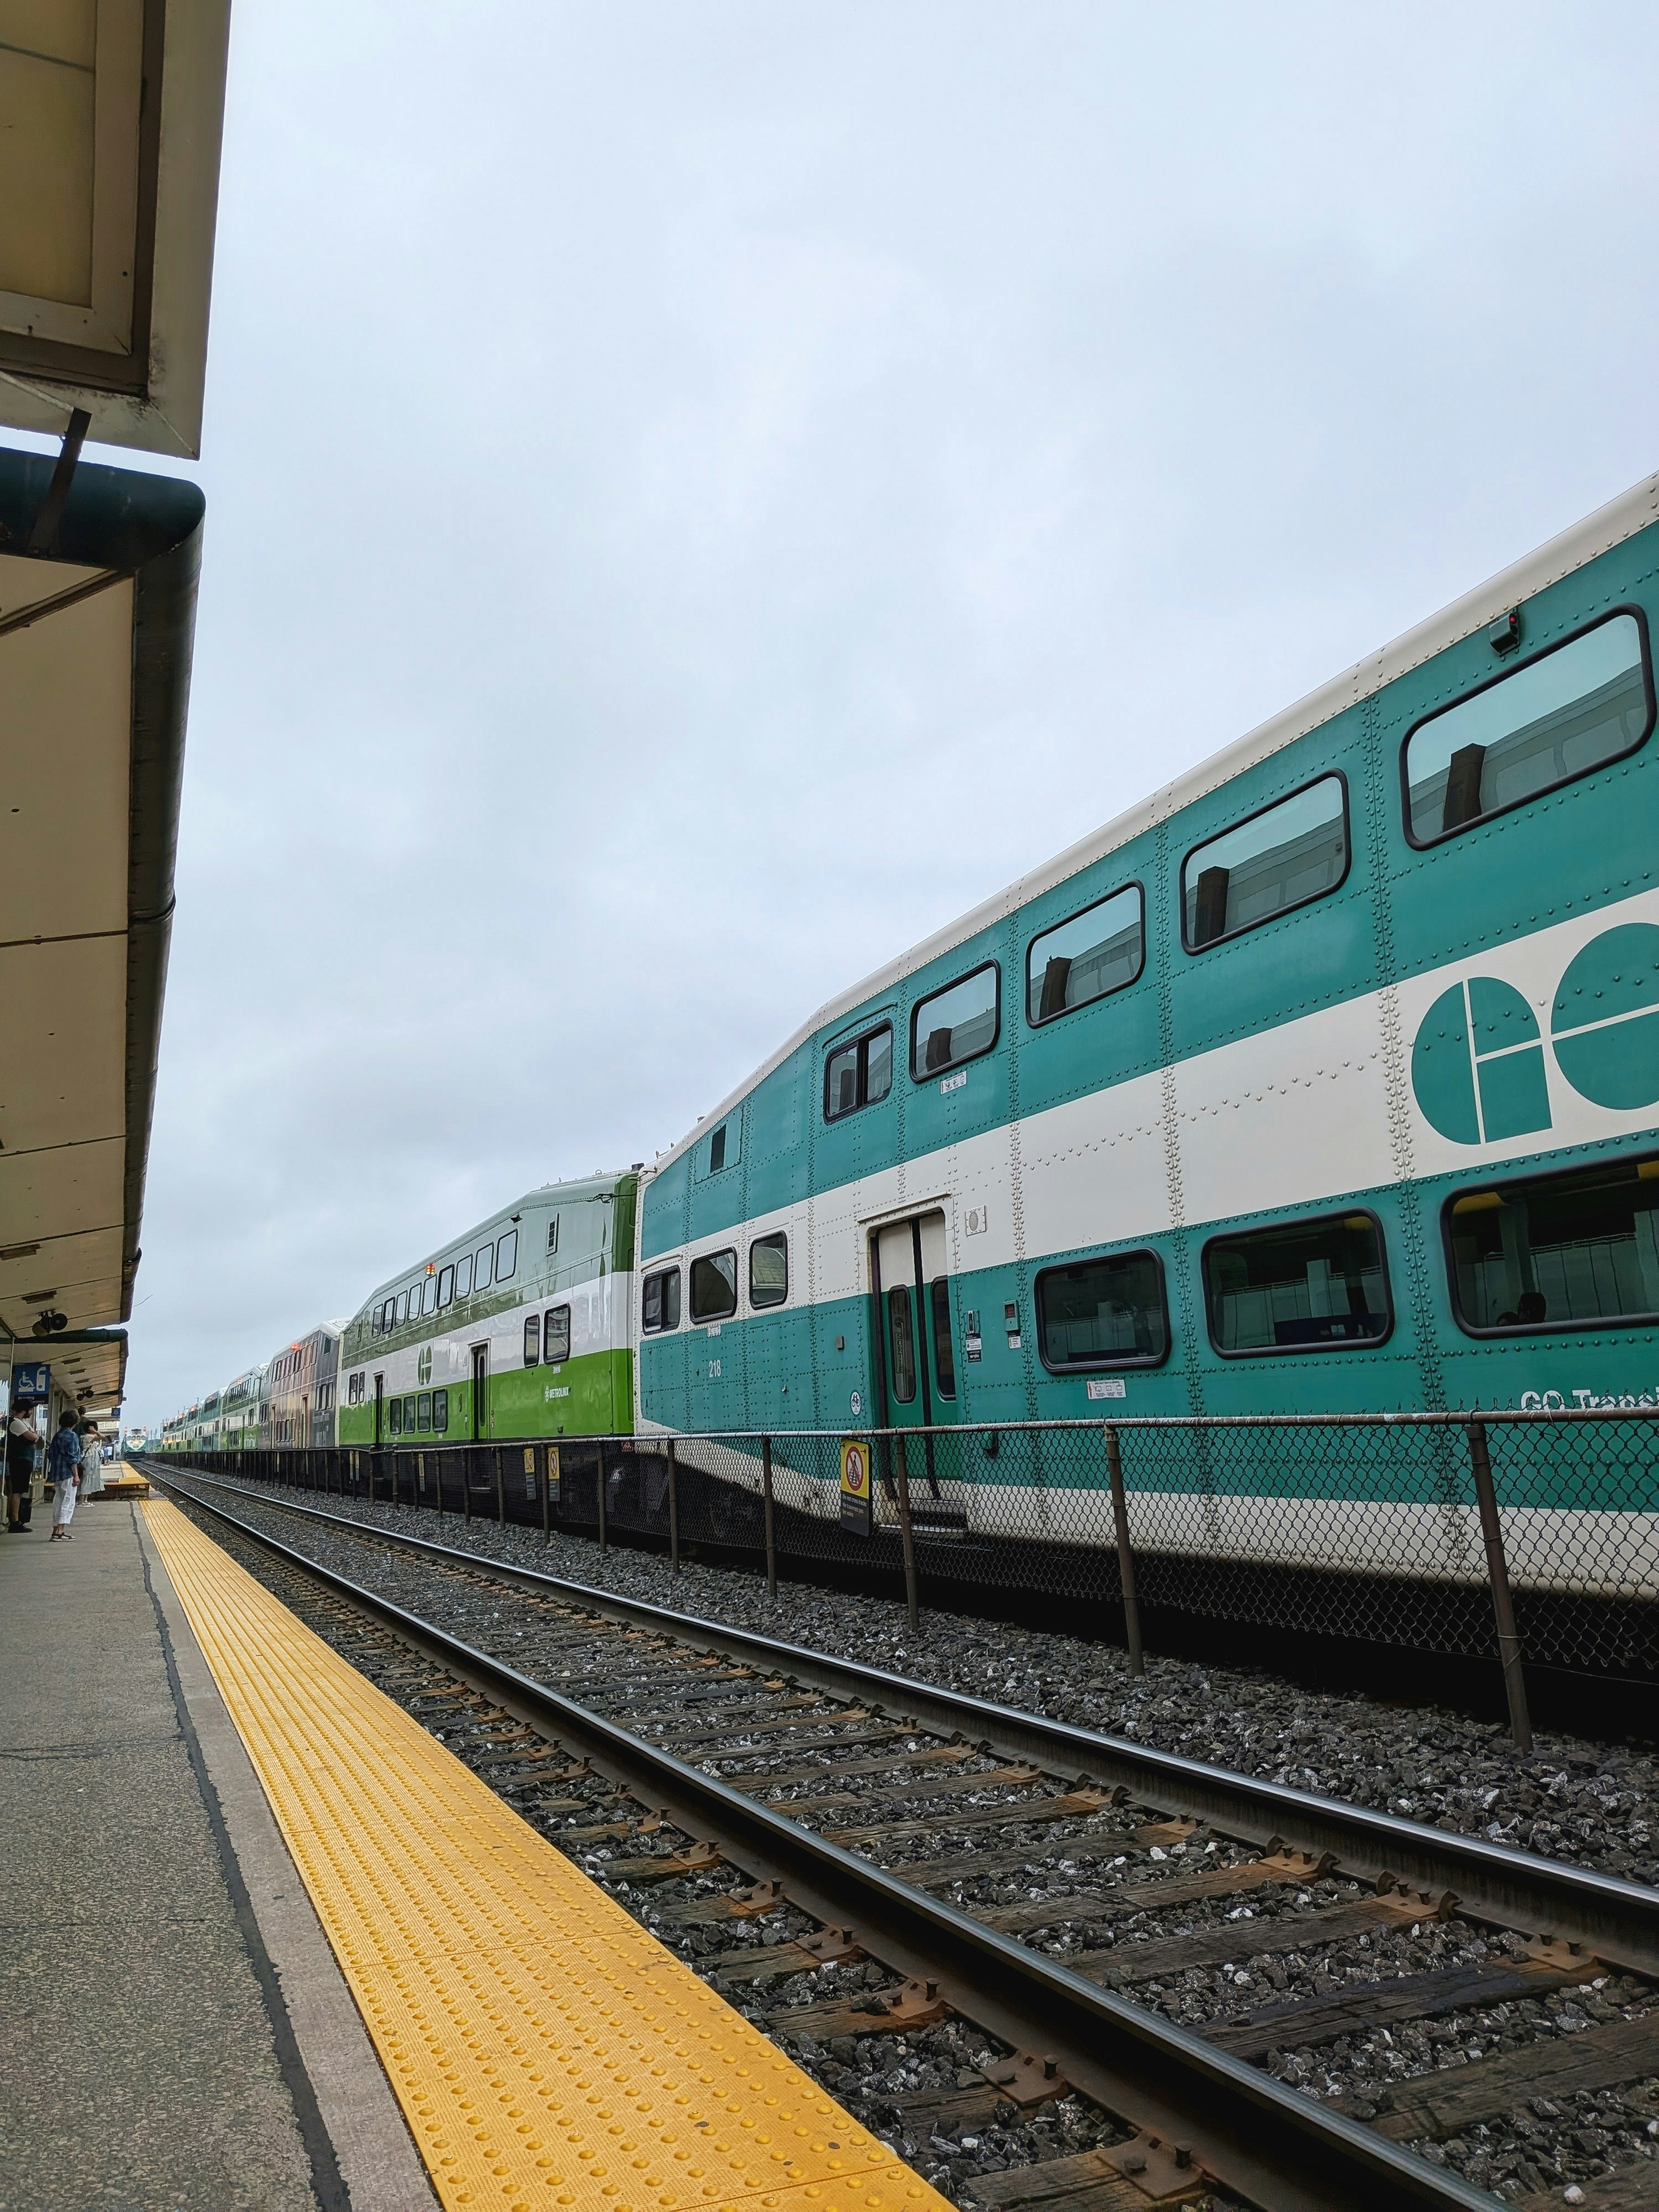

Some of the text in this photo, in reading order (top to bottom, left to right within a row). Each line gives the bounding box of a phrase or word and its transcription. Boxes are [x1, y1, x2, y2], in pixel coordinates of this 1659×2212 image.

[709, 1359, 721, 1378] 218
[549, 1387, 569, 1399] METROLINX
[1521, 1390, 1565, 1411] GO
